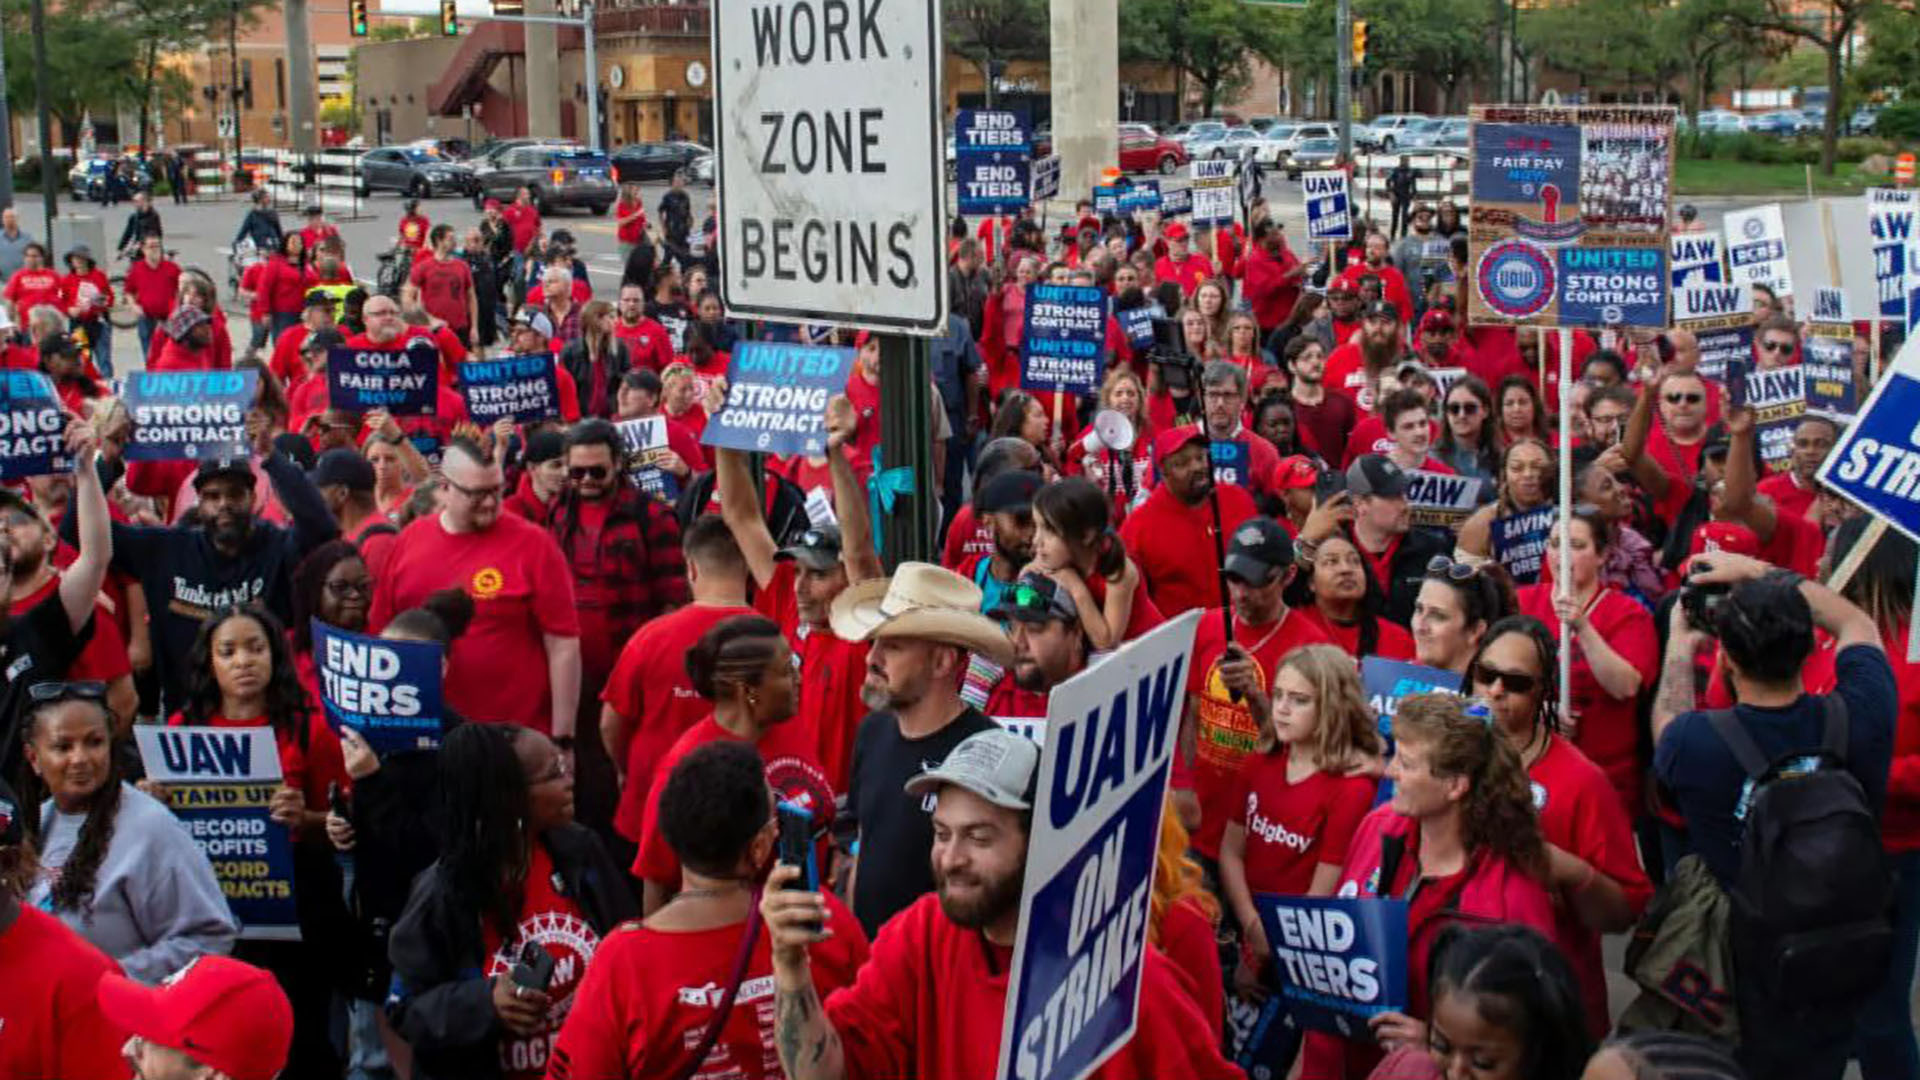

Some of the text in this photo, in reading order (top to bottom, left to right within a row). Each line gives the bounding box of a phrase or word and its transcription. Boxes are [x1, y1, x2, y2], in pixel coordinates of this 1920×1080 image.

[752, 0, 888, 67] WORK
[975, 114, 1015, 129] END
[760, 108, 887, 174] ZONE
[965, 130, 1023, 145] TIERS
[976, 166, 1015, 181] END
[1197, 162, 1226, 176] UAW
[1493, 157, 1564, 170] FAIR PAY
[967, 182, 1023, 197] TIERS
[1305, 176, 1343, 193] UAW
[1870, 211, 1912, 238] AW
[741, 217, 916, 288] BEGINS
[1566, 250, 1656, 268] UNITED
[1748, 264, 1771, 279] ON
[1567, 275, 1657, 289] STRONG
[1034, 286, 1100, 301] UNITED
[1565, 291, 1660, 304] CONTRACT
[1687, 288, 1739, 314] UAW
[1032, 304, 1099, 318] STRONG
[1030, 316, 1101, 329] CONTRACT
[1029, 338, 1096, 354] UNITED
[355, 352, 410, 368] COLA
[463, 356, 545, 381] UNITED
[738, 346, 841, 375] UNITED
[1028, 356, 1095, 371] STRONG
[138, 374, 244, 394] UNITED
[340, 373, 427, 390] FAIR PAY
[1026, 371, 1095, 382] CONTRACT
[1748, 370, 1800, 402] UAW
[358, 390, 406, 404] NOW
[468, 380, 548, 403] STRONG
[728, 382, 828, 411] STRONG
[135, 404, 241, 425] STRONG
[470, 395, 550, 415] CONTRACT
[0, 409, 60, 435] ONG
[720, 408, 825, 433] CONTRACT
[134, 426, 245, 443] CONTRACT
[617, 421, 653, 451] AW
[1761, 427, 1794, 442] COL
[0, 434, 63, 456] RACT
[1838, 438, 1920, 501] STR
[1504, 512, 1553, 539] SAVIN
[1501, 540, 1549, 563] AMERI
[1512, 557, 1540, 576] DRE
[327, 635, 400, 681] END
[321, 668, 421, 716] TIERS
[1050, 653, 1182, 829] UAW
[158, 732, 251, 776] UAW
[170, 789, 238, 804] TAND
[1251, 816, 1312, 853] bigboy
[215, 862, 270, 878] CORD
[223, 881, 290, 898] RACTS
[1067, 818, 1126, 957] ON
[1276, 906, 1354, 953] END
[1015, 877, 1147, 1080] STRIKE
[1277, 948, 1379, 1002] TIERS
